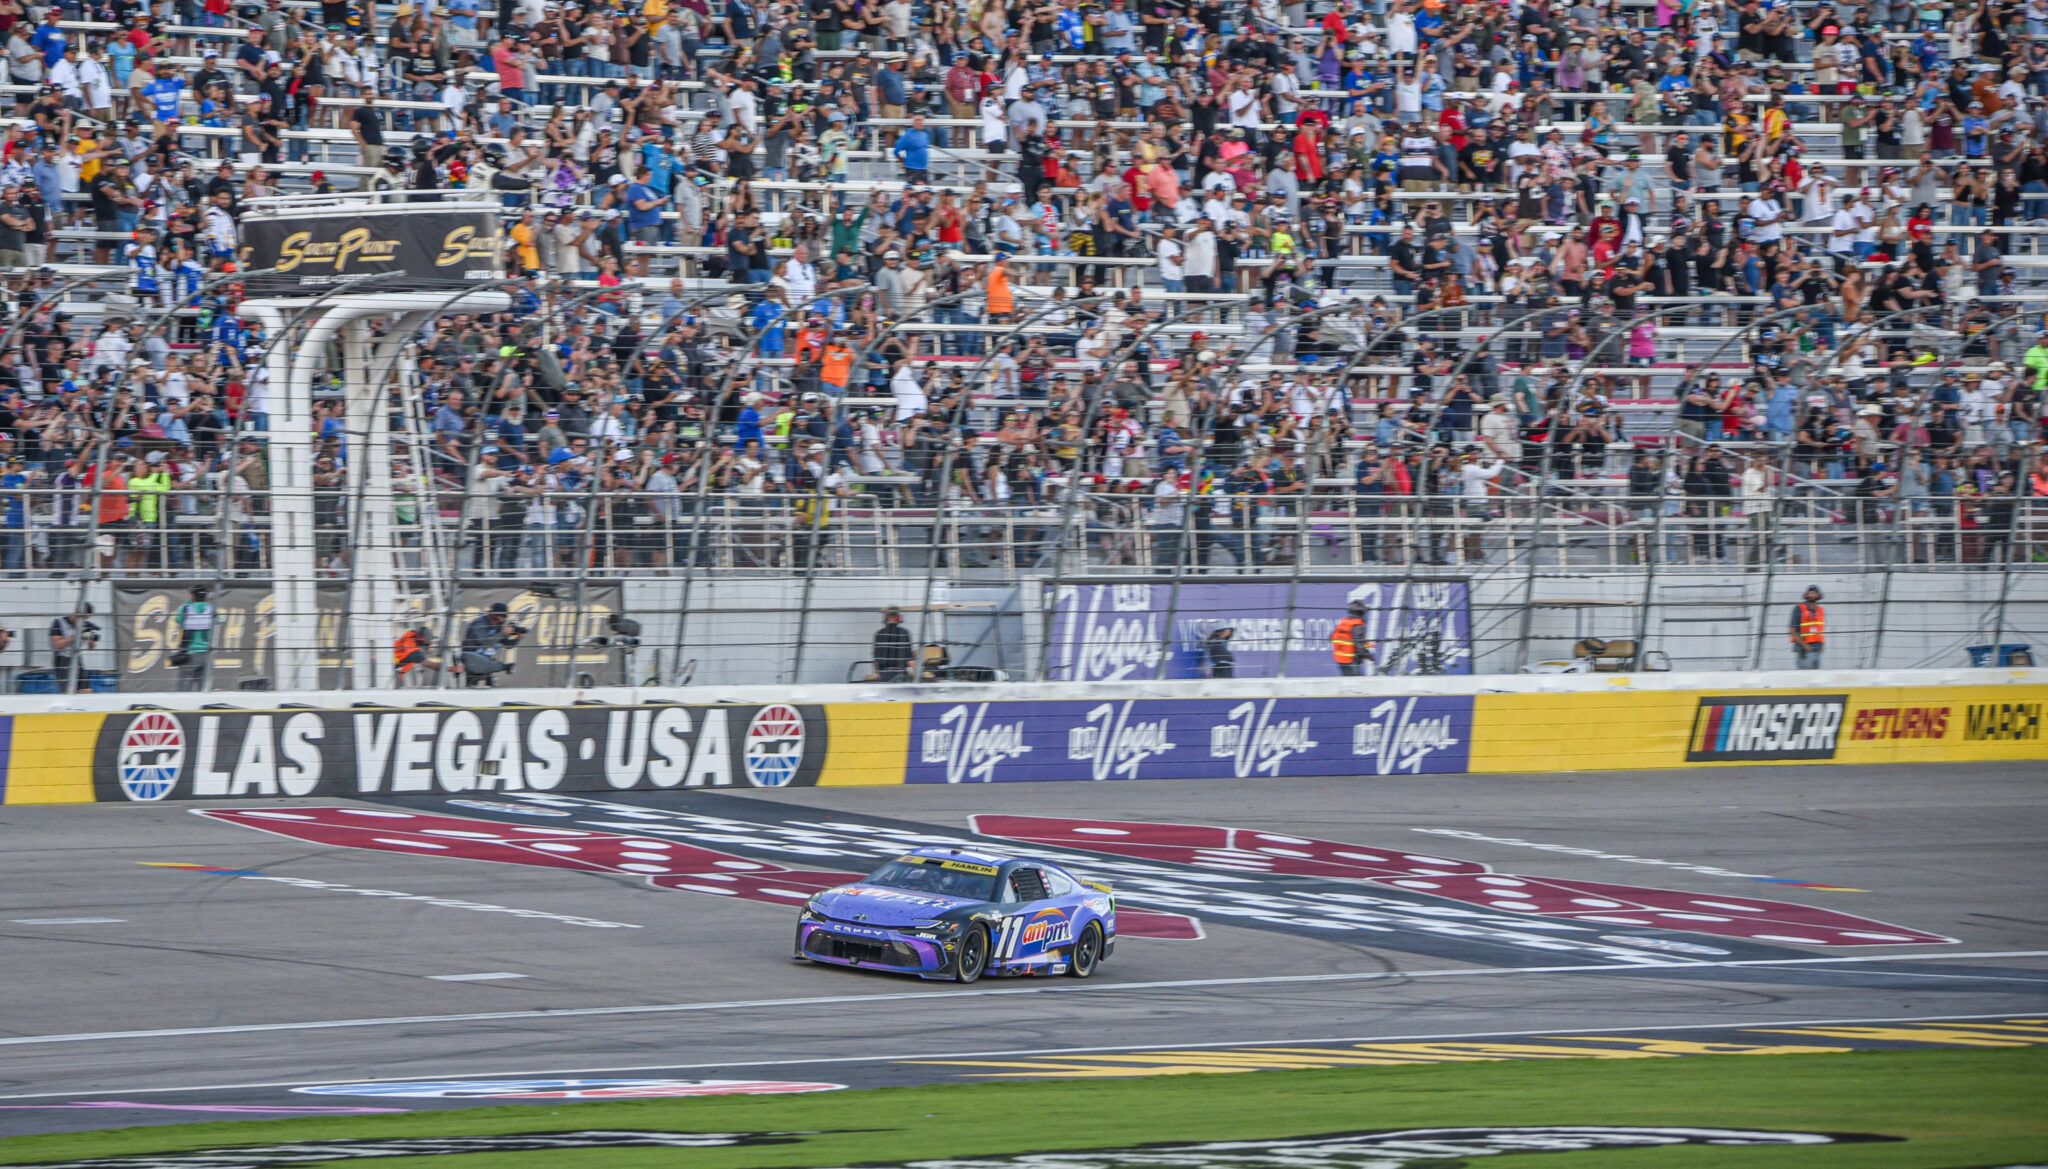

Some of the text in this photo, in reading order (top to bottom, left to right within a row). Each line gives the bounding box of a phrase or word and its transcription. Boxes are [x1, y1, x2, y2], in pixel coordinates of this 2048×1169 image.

[1725, 703, 2042, 752] NASCAR RETURNS MARCH
[193, 706, 733, 797] LAS VEGAS USA
[951, 862, 993, 873] HAMLIN
[993, 916, 1026, 959] 11
[1022, 919, 1074, 952] ampm
